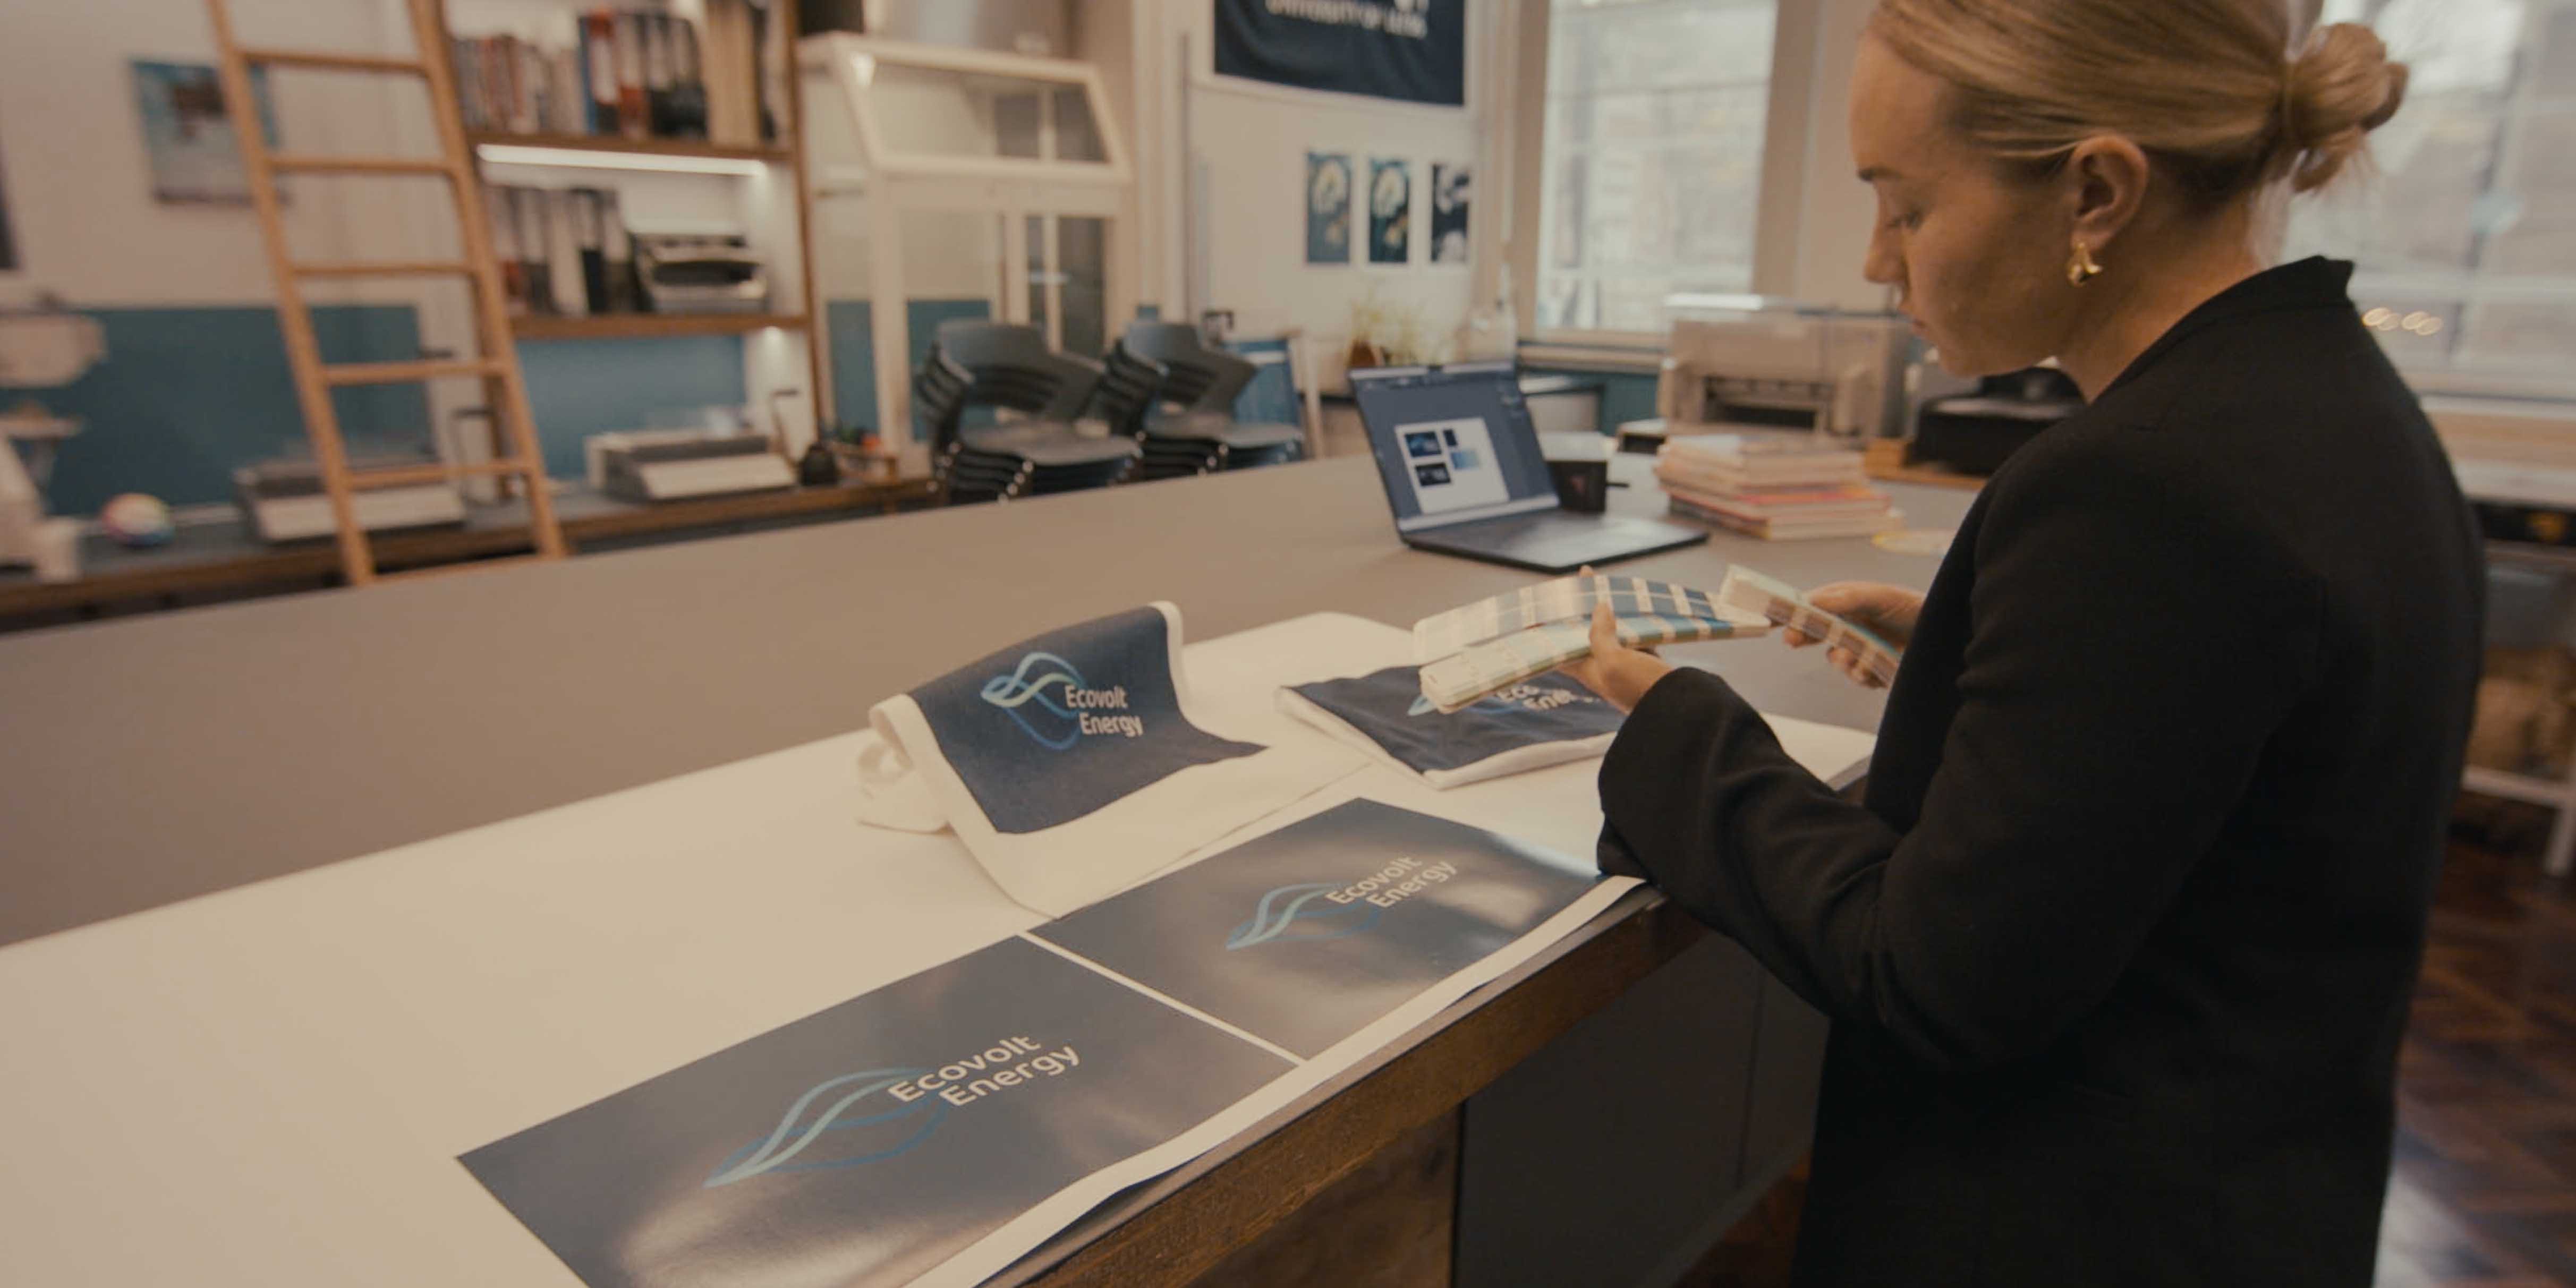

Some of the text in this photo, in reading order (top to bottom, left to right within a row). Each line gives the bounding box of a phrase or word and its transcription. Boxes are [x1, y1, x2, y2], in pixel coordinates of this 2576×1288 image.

[1065, 684, 1128, 709] Ecovolt
[1079, 712, 1144, 738] Energy
[1325, 856, 1423, 904] Ecovolt
[1365, 860, 1457, 908] Energy
[888, 1036, 1042, 1102] Ecovolt
[938, 1046, 1080, 1106] Energy
